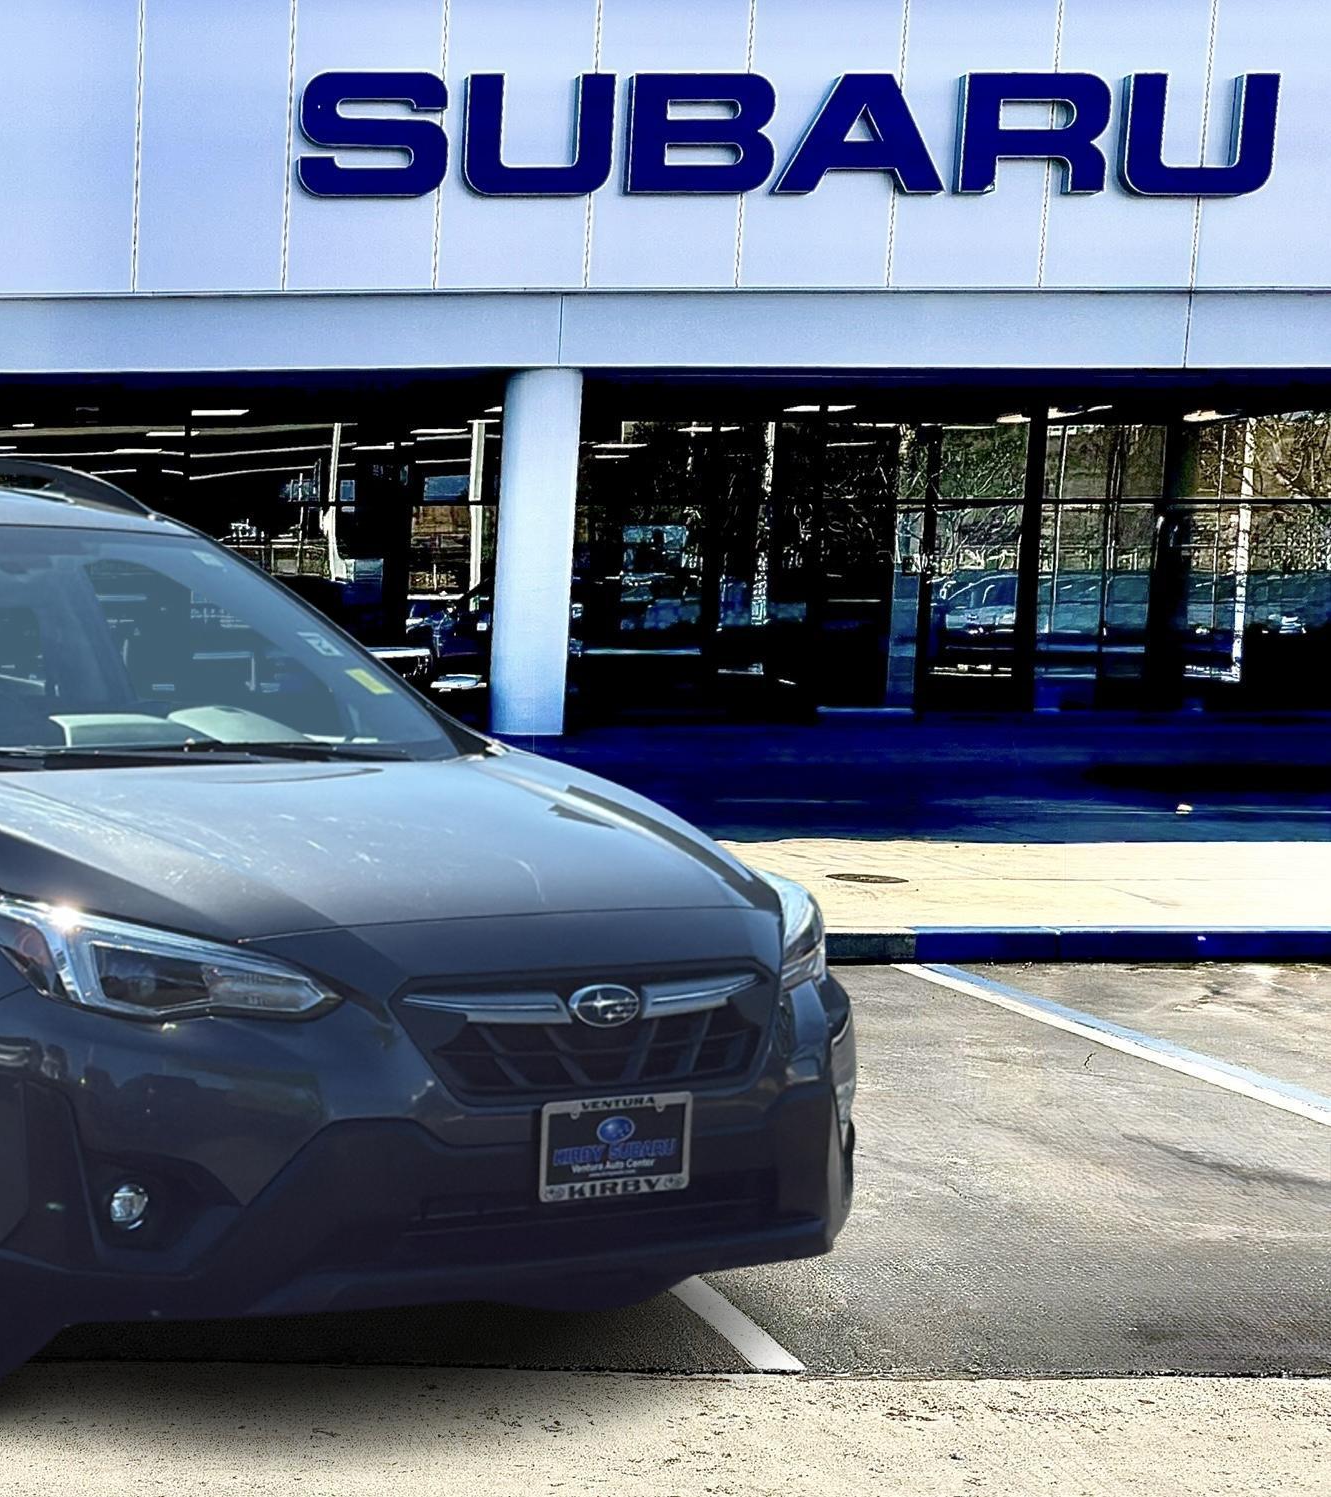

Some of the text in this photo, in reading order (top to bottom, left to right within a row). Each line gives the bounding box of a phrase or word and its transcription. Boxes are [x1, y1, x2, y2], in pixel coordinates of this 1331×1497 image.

[296, 71, 1281, 198] SUBARU
[581, 1096, 655, 1110] VENTURA
[553, 1138, 677, 1166] KIRBY SUBARU
[571, 1163, 603, 1174] Ventura
[605, 1160, 624, 1170] Auto
[626, 1158, 655, 1168] Center
[568, 1178, 660, 1199] KIRBY
